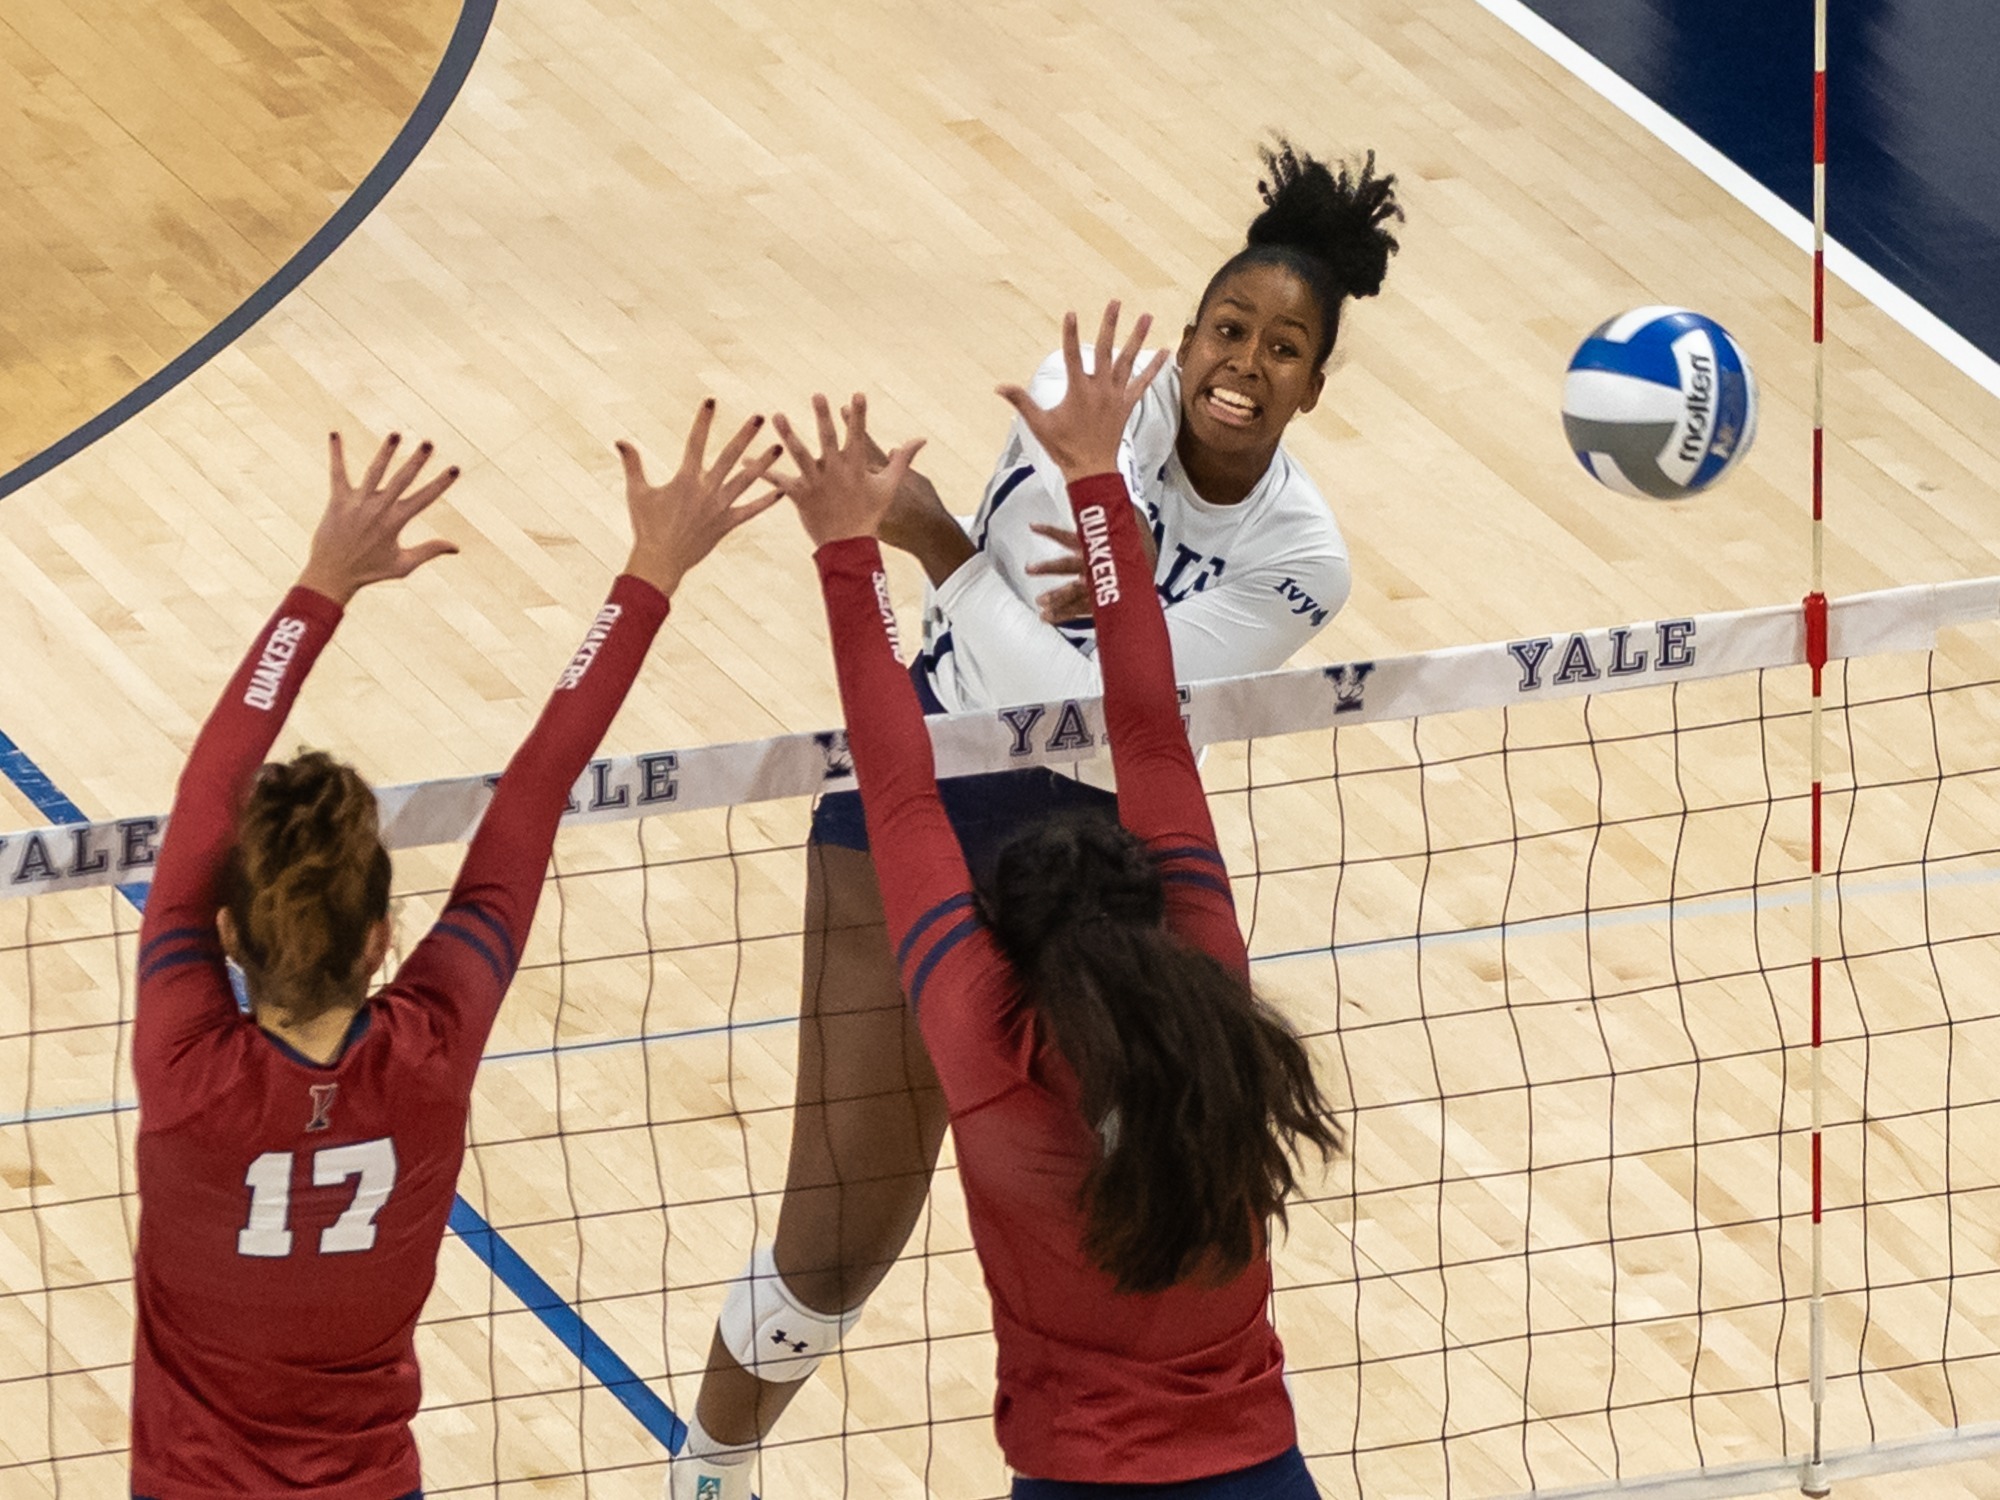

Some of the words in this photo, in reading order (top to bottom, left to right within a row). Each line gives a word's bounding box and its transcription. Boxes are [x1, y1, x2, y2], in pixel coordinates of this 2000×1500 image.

[1679, 352, 1711, 462] molten
[1079, 505, 1120, 607] QUAKERS
[1273, 577, 1318, 614] Ivy
[243, 617, 306, 711] QUAKERS
[1508, 618, 1695, 691] YALE
[484, 751, 679, 816] LE
[0, 815, 158, 884] ALE
[237, 1136, 398, 1258] 17
